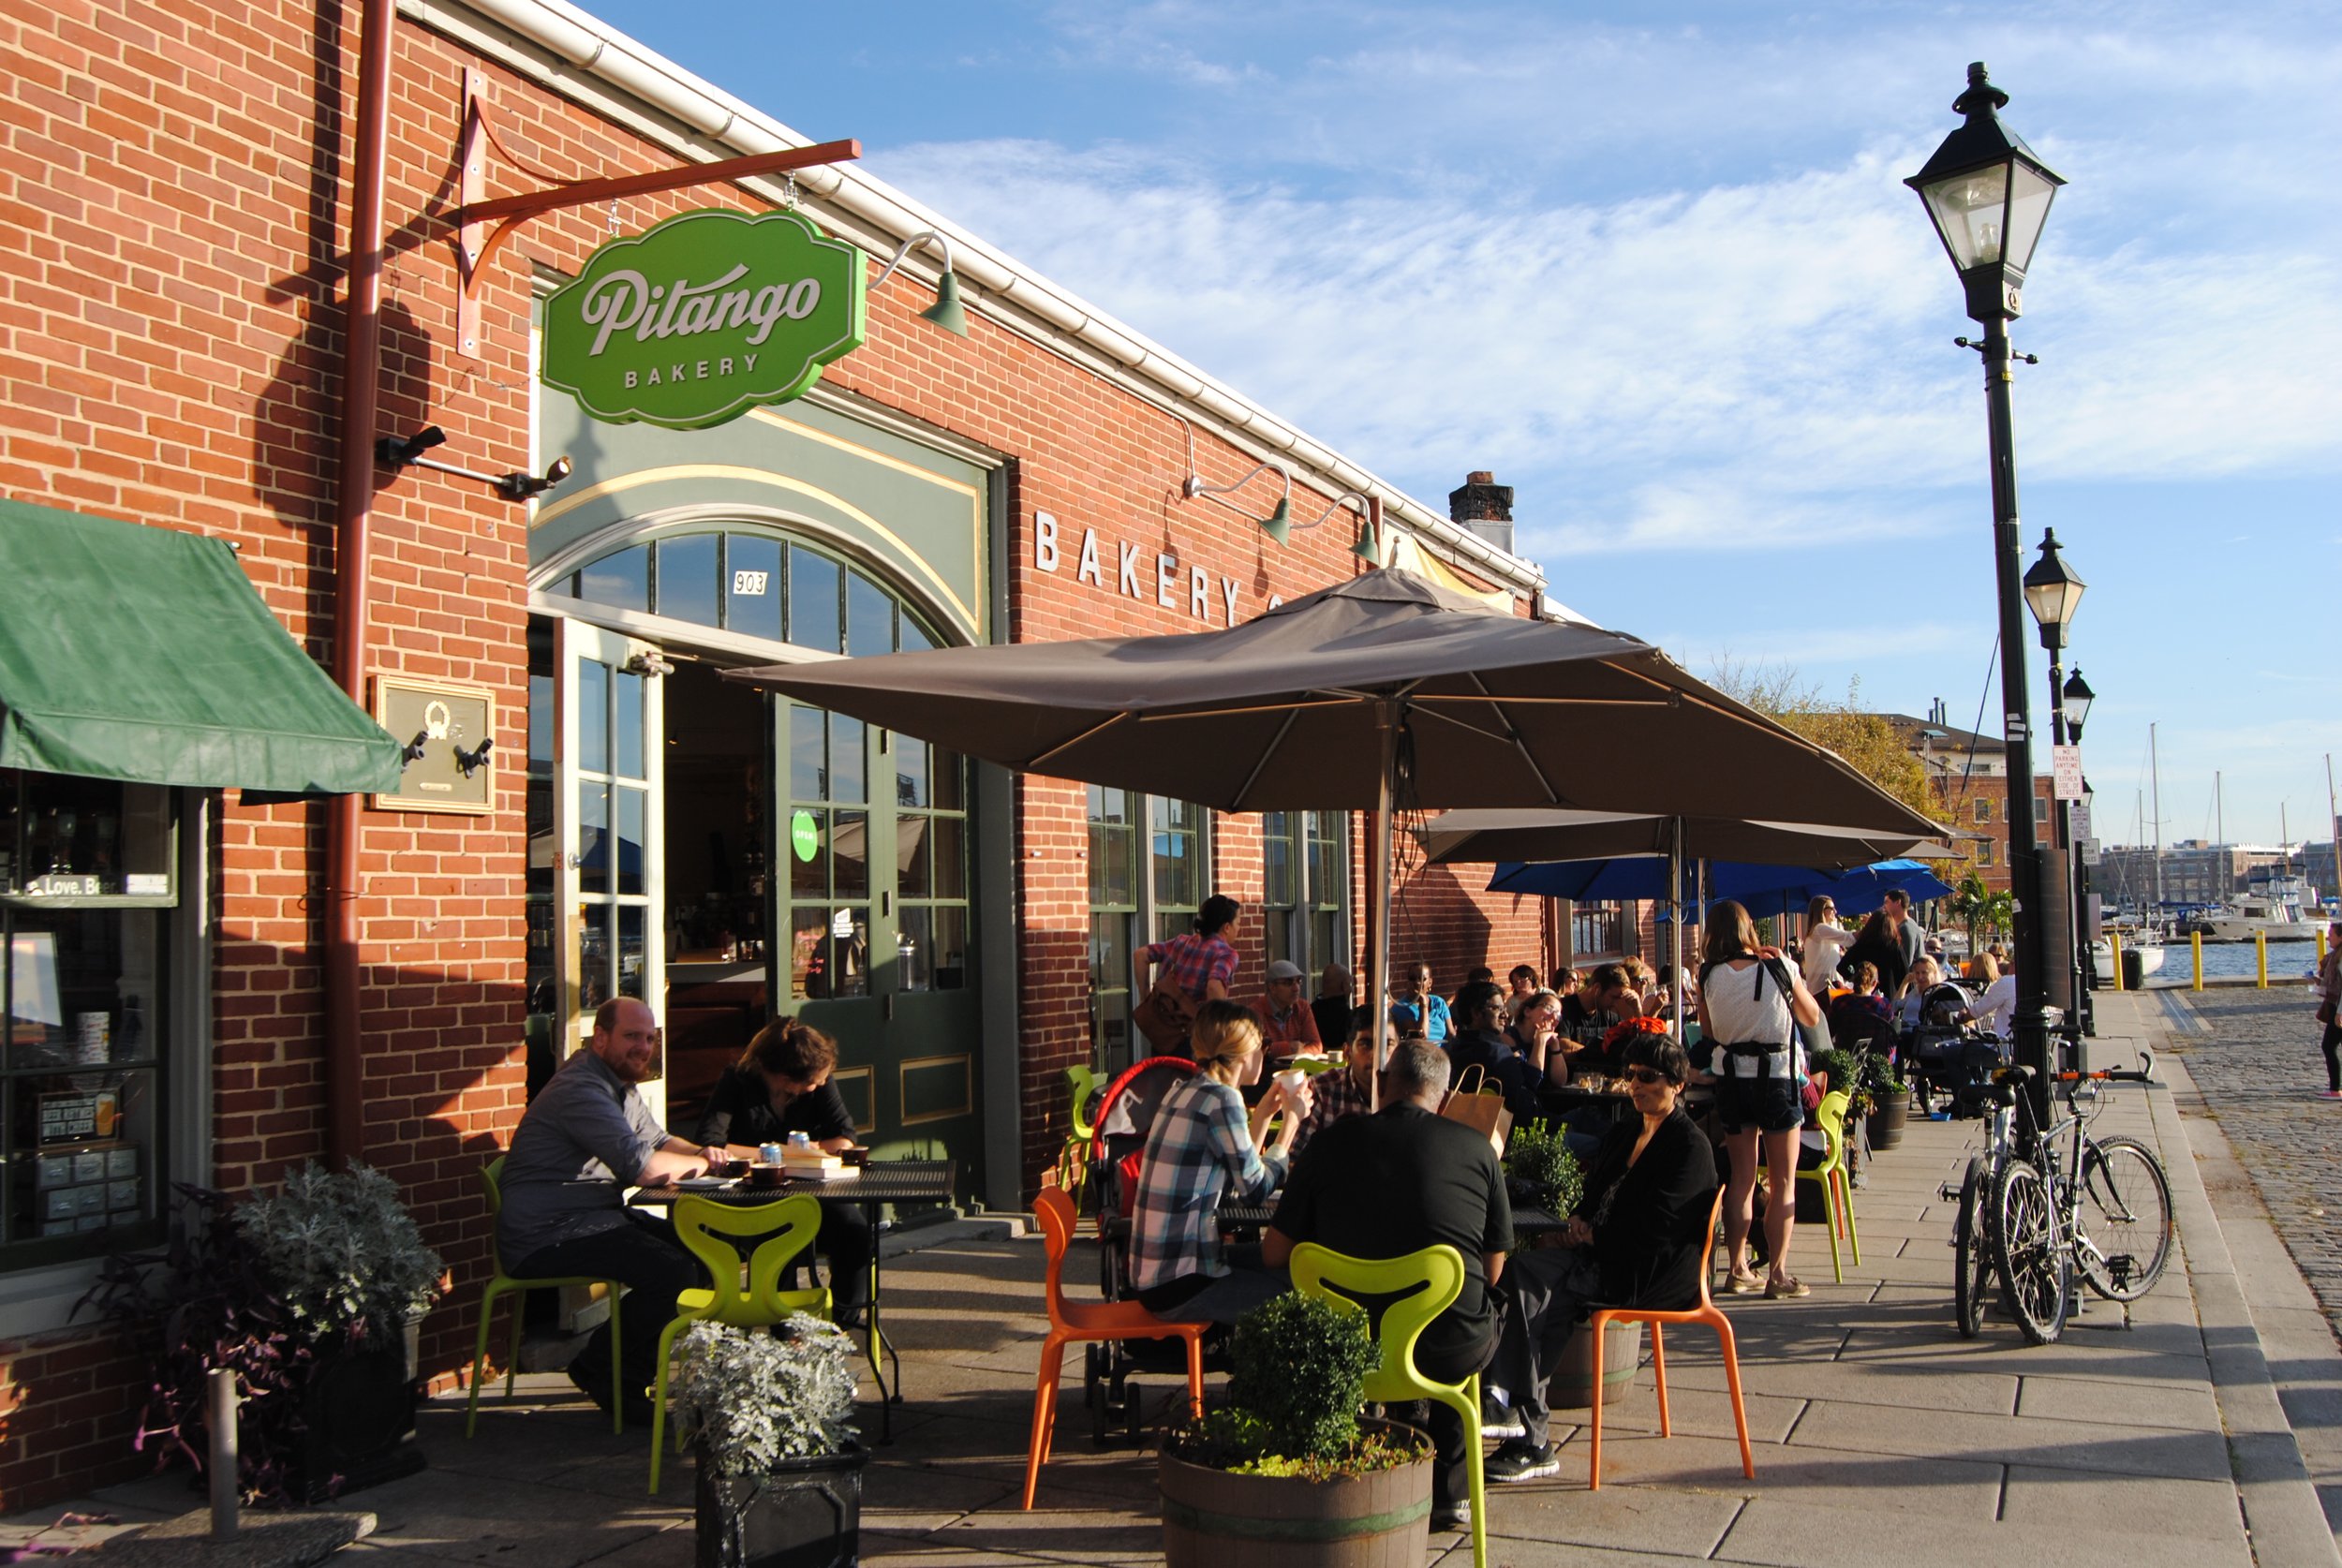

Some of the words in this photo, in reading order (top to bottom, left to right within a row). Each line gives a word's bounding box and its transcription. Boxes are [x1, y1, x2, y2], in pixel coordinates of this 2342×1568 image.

[581, 263, 822, 357] Pitango
[624, 354, 760, 390] BAKERY
[735, 573, 763, 593] 903
[1034, 510, 1240, 629] BAKERY
[795, 830, 814, 840] OPEN
[45, 877, 82, 895] Love.
[84, 877, 119, 895] Beer.
